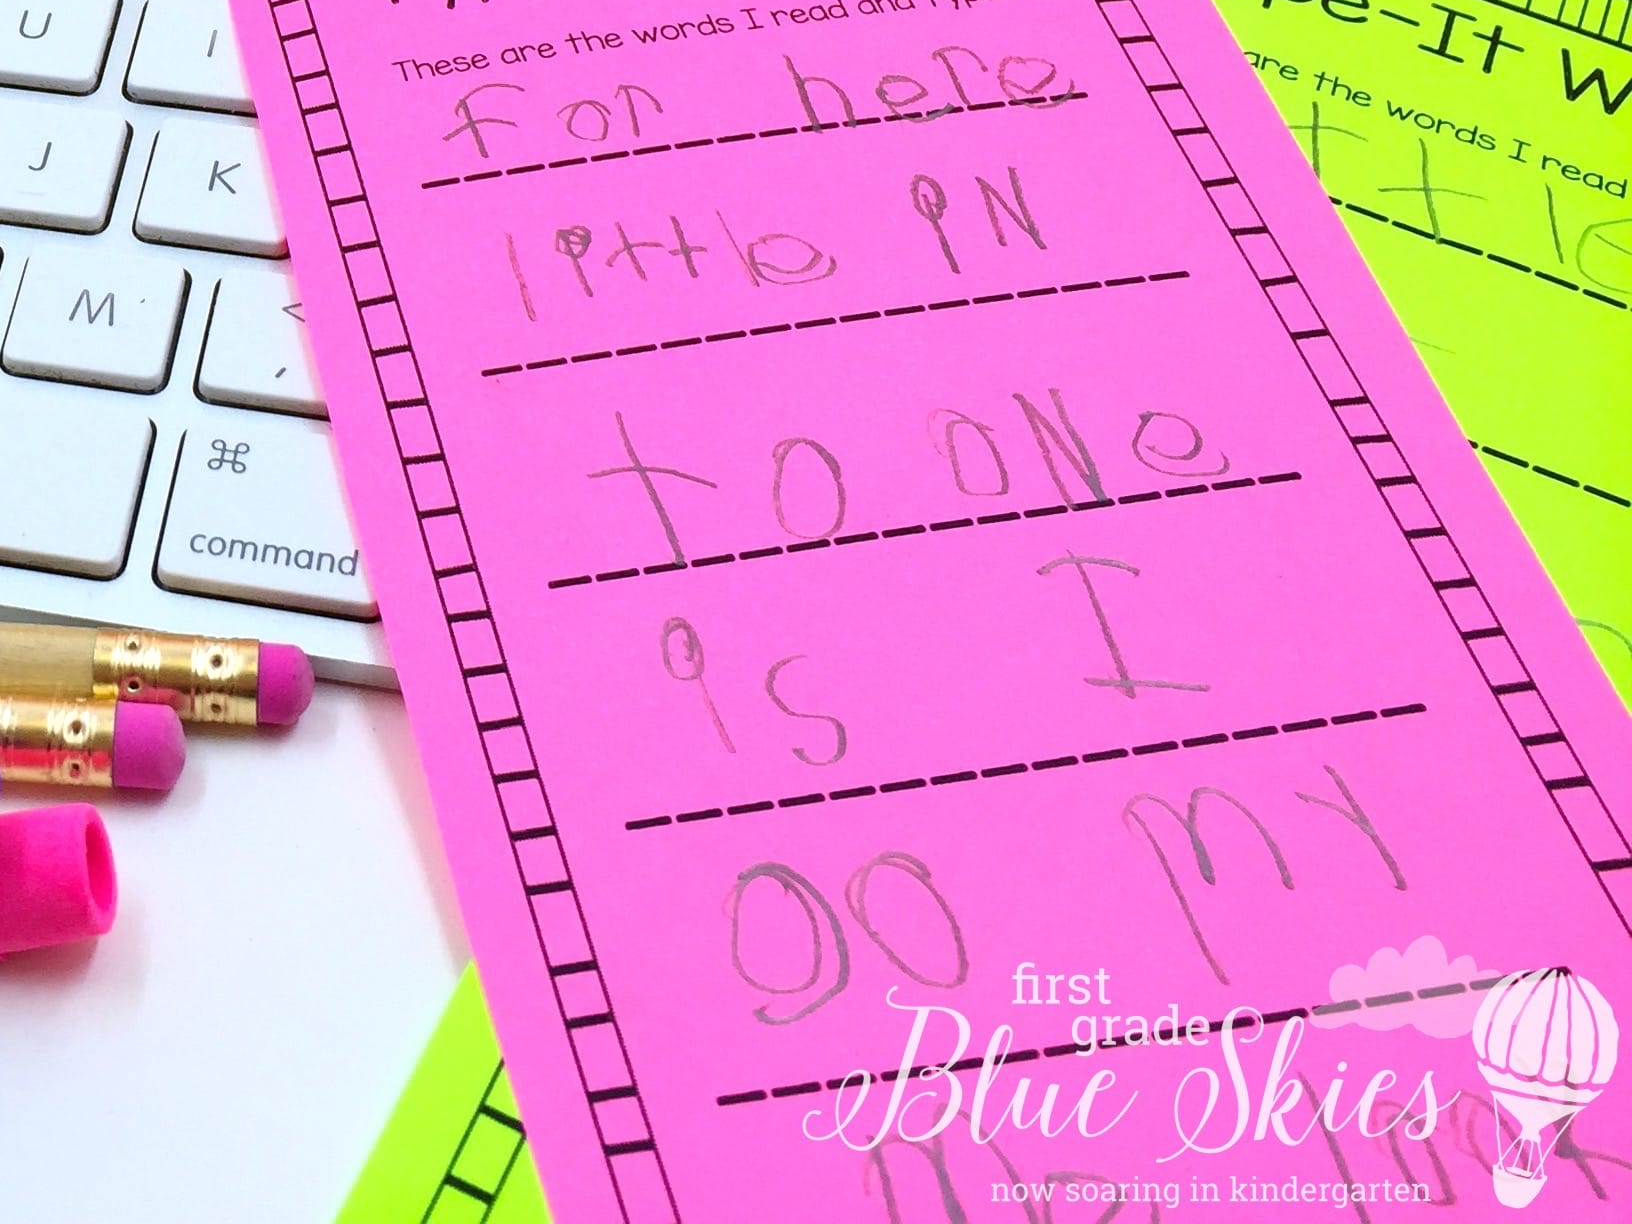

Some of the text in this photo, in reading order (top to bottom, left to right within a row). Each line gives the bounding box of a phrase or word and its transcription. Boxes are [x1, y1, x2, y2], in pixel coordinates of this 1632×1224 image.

[18, 9, 53, 40] U
[206, 29, 218, 58] I
[391, 48, 490, 83] These
[500, 40, 558, 66] are
[565, 26, 625, 56] the
[631, 10, 736, 45] words
[740, 7, 765, 30] I
[782, 45, 1075, 135] here
[1313, 70, 1373, 108] the
[1386, 99, 1498, 153] words
[1507, 137, 1533, 164] I
[1540, 153, 1629, 200] read
[27, 141, 53, 172] J
[208, 159, 242, 195] K
[68, 288, 115, 327] M
[189, 533, 360, 578] command
[1036, 549, 1212, 701] I
